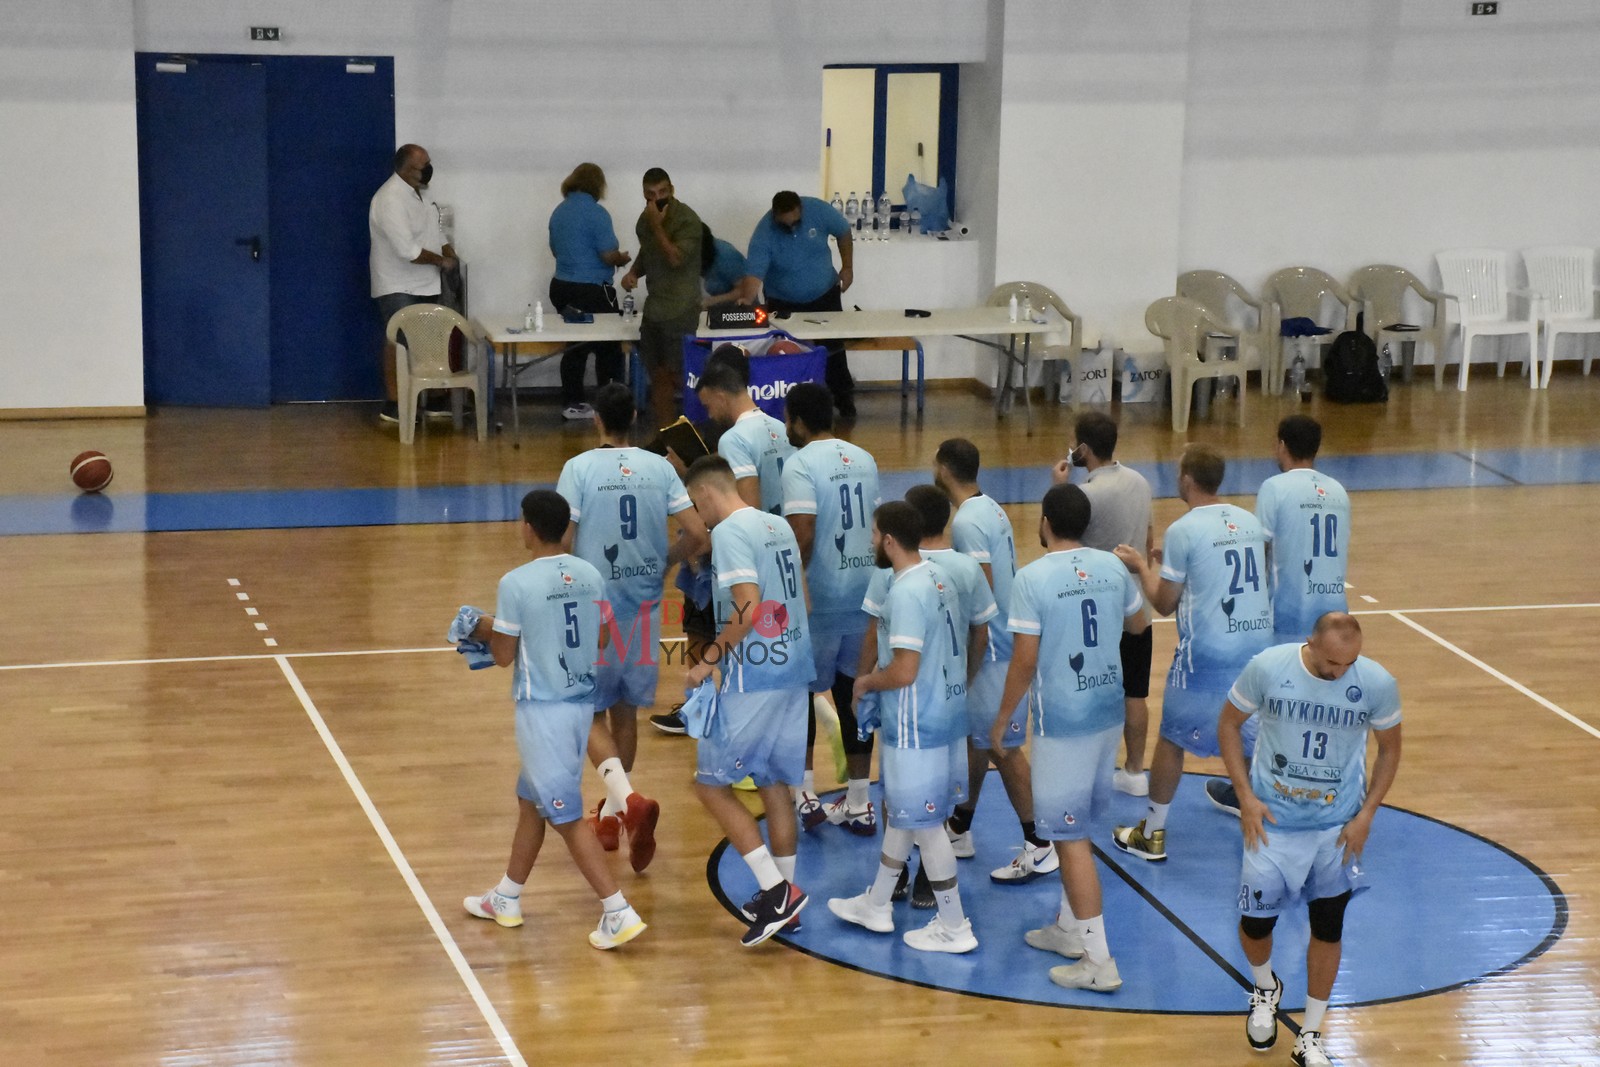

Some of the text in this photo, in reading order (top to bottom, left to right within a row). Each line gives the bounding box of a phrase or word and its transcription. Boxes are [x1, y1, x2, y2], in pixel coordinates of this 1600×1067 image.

[722, 312, 756, 321] POSSESSION
[619, 494, 638, 541] 9
[840, 482, 866, 531] 91
[1310, 512, 1339, 558] 10
[609, 563, 658, 580] Brouzos
[775, 548, 797, 601] 15
[1225, 546, 1260, 596] 24
[563, 601, 581, 649] 5
[946, 609, 959, 657] 1
[1080, 598, 1099, 648] 6
[1225, 617, 1272, 634] Brouzos
[1266, 697, 1369, 730] MYKONOS
[1301, 730, 1329, 760] 13
[1288, 764, 1309, 776] SEA
